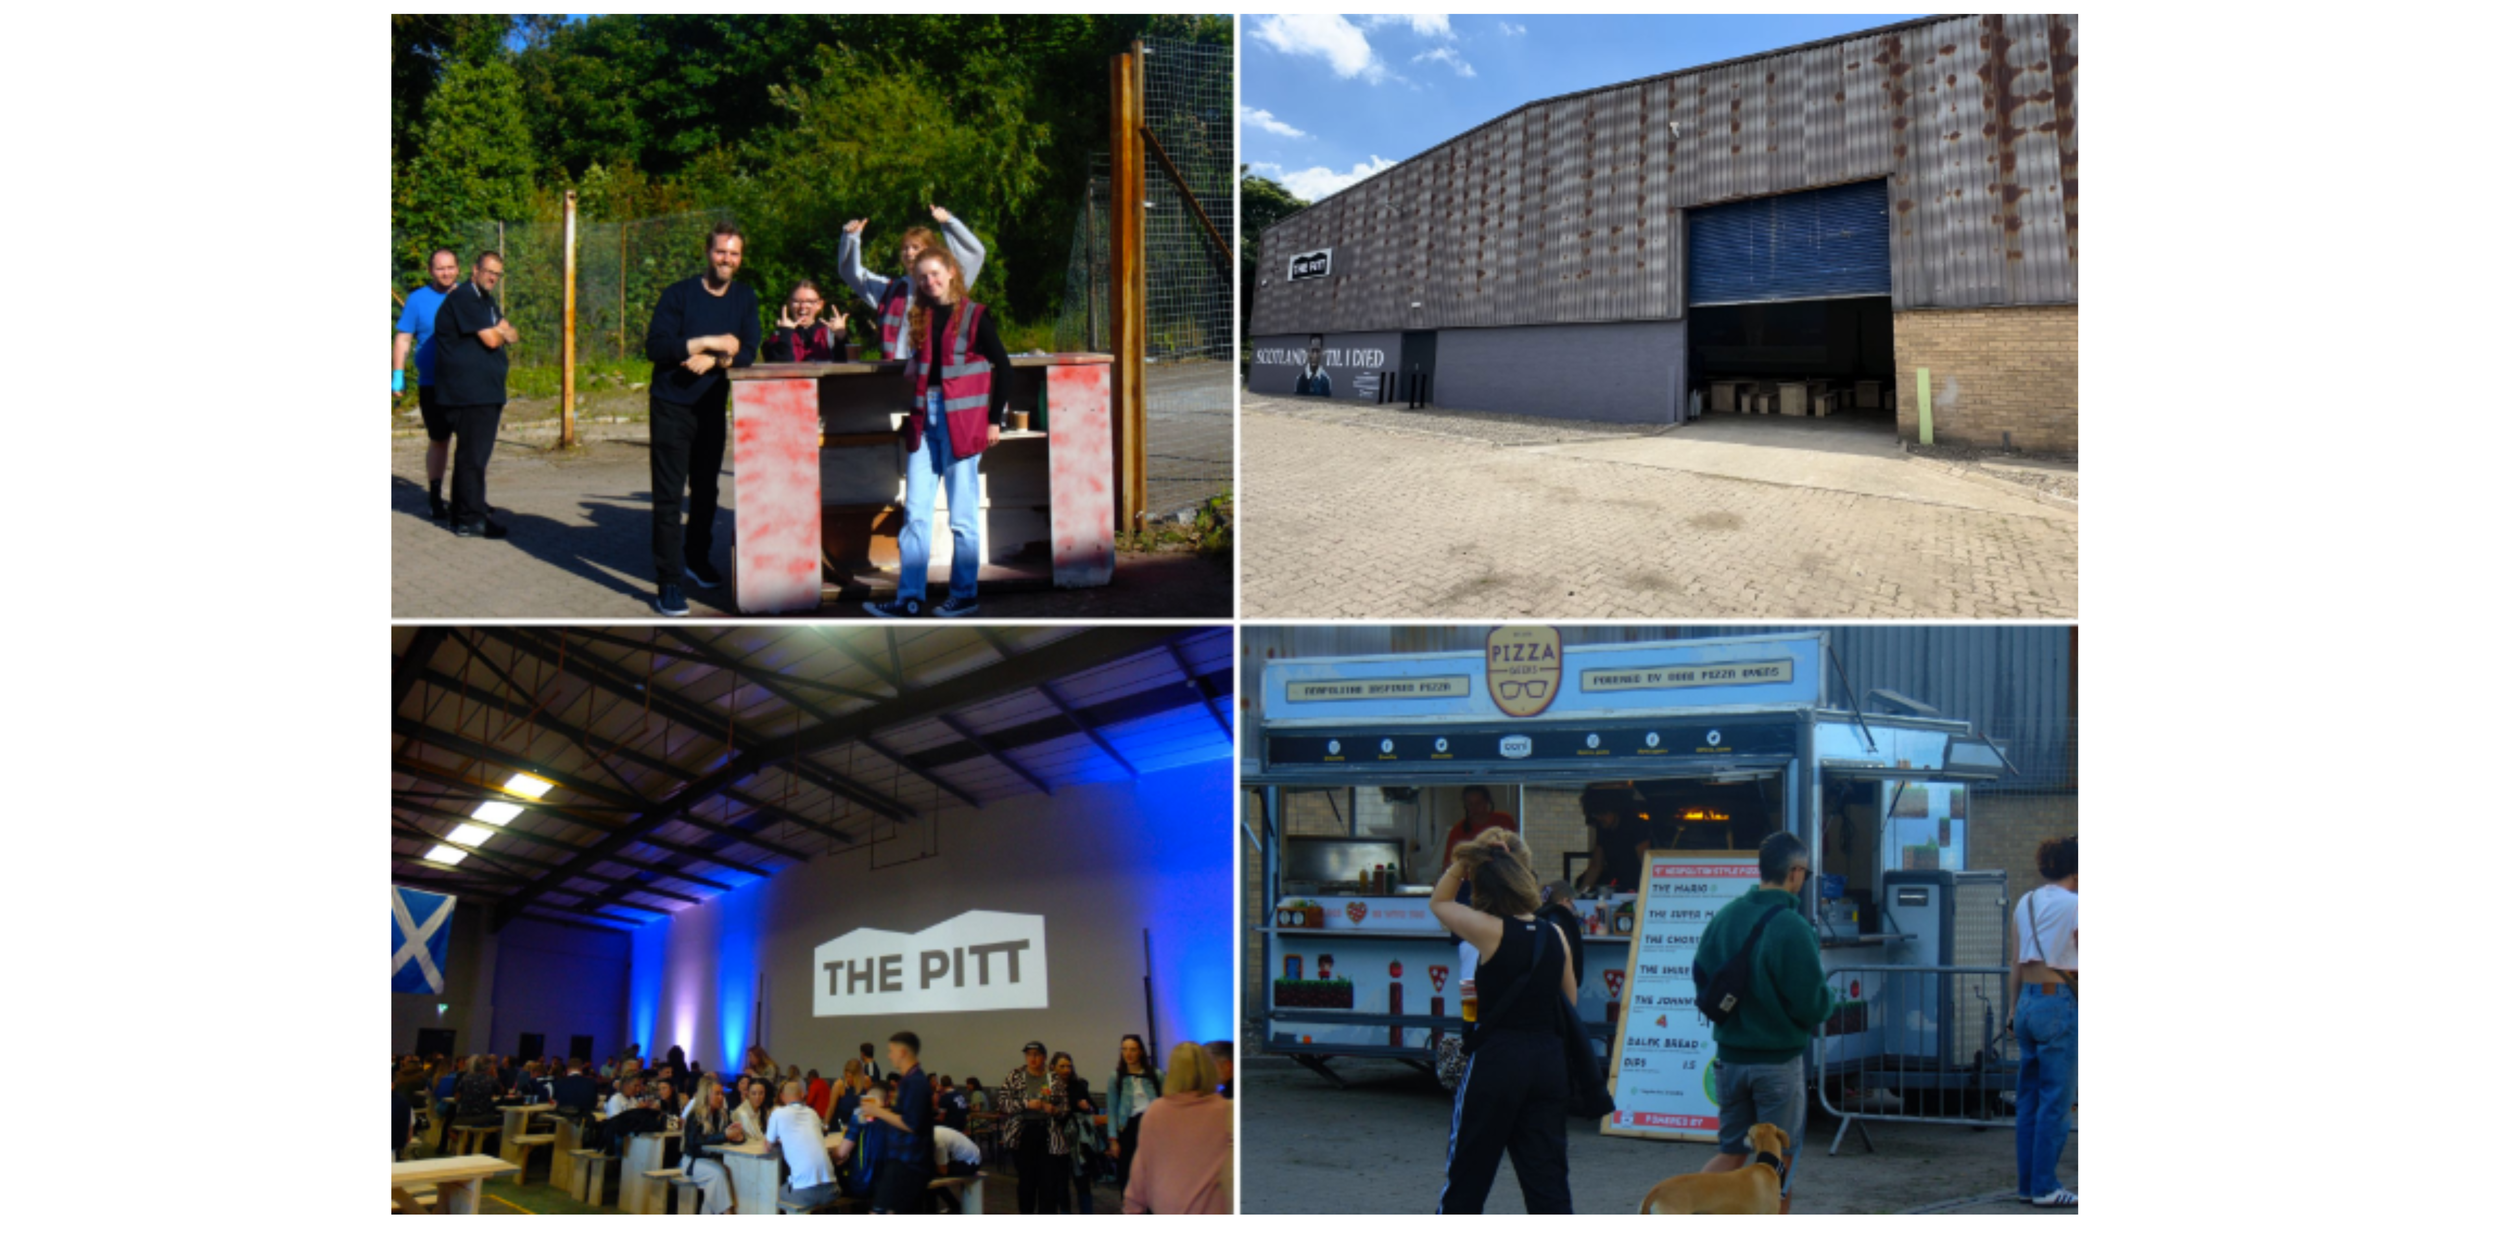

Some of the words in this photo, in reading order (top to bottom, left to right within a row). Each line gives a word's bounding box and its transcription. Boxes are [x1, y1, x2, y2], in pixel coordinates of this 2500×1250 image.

[1294, 263, 1308, 275] THE
[1309, 259, 1326, 272] PITT
[1353, 348, 1384, 367] DIED
[1492, 643, 1555, 662] PIZZA
[1593, 674, 1641, 685] POWERED
[1648, 672, 1661, 683] BY
[1702, 669, 1735, 680] PIZZA
[1742, 667, 1779, 677] OVENS
[1420, 682, 1450, 692] PIZZA
[1652, 884, 1670, 892] THE
[1674, 884, 1708, 892] MARIO
[1649, 910, 1666, 918] THE
[1670, 910, 1701, 918] SUPER
[1645, 934, 1662, 944] THE
[824, 954, 902, 996] THE
[920, 939, 1030, 990] PITT
[1640, 965, 1658, 974] THE
[1635, 995, 1653, 1004] THE
[1663, 1039, 1699, 1048] BREAD
[1624, 1058, 1646, 1068] DIPS
[1645, 1114, 1688, 1126] POWERED
[1690, 1118, 1703, 1126] BY
